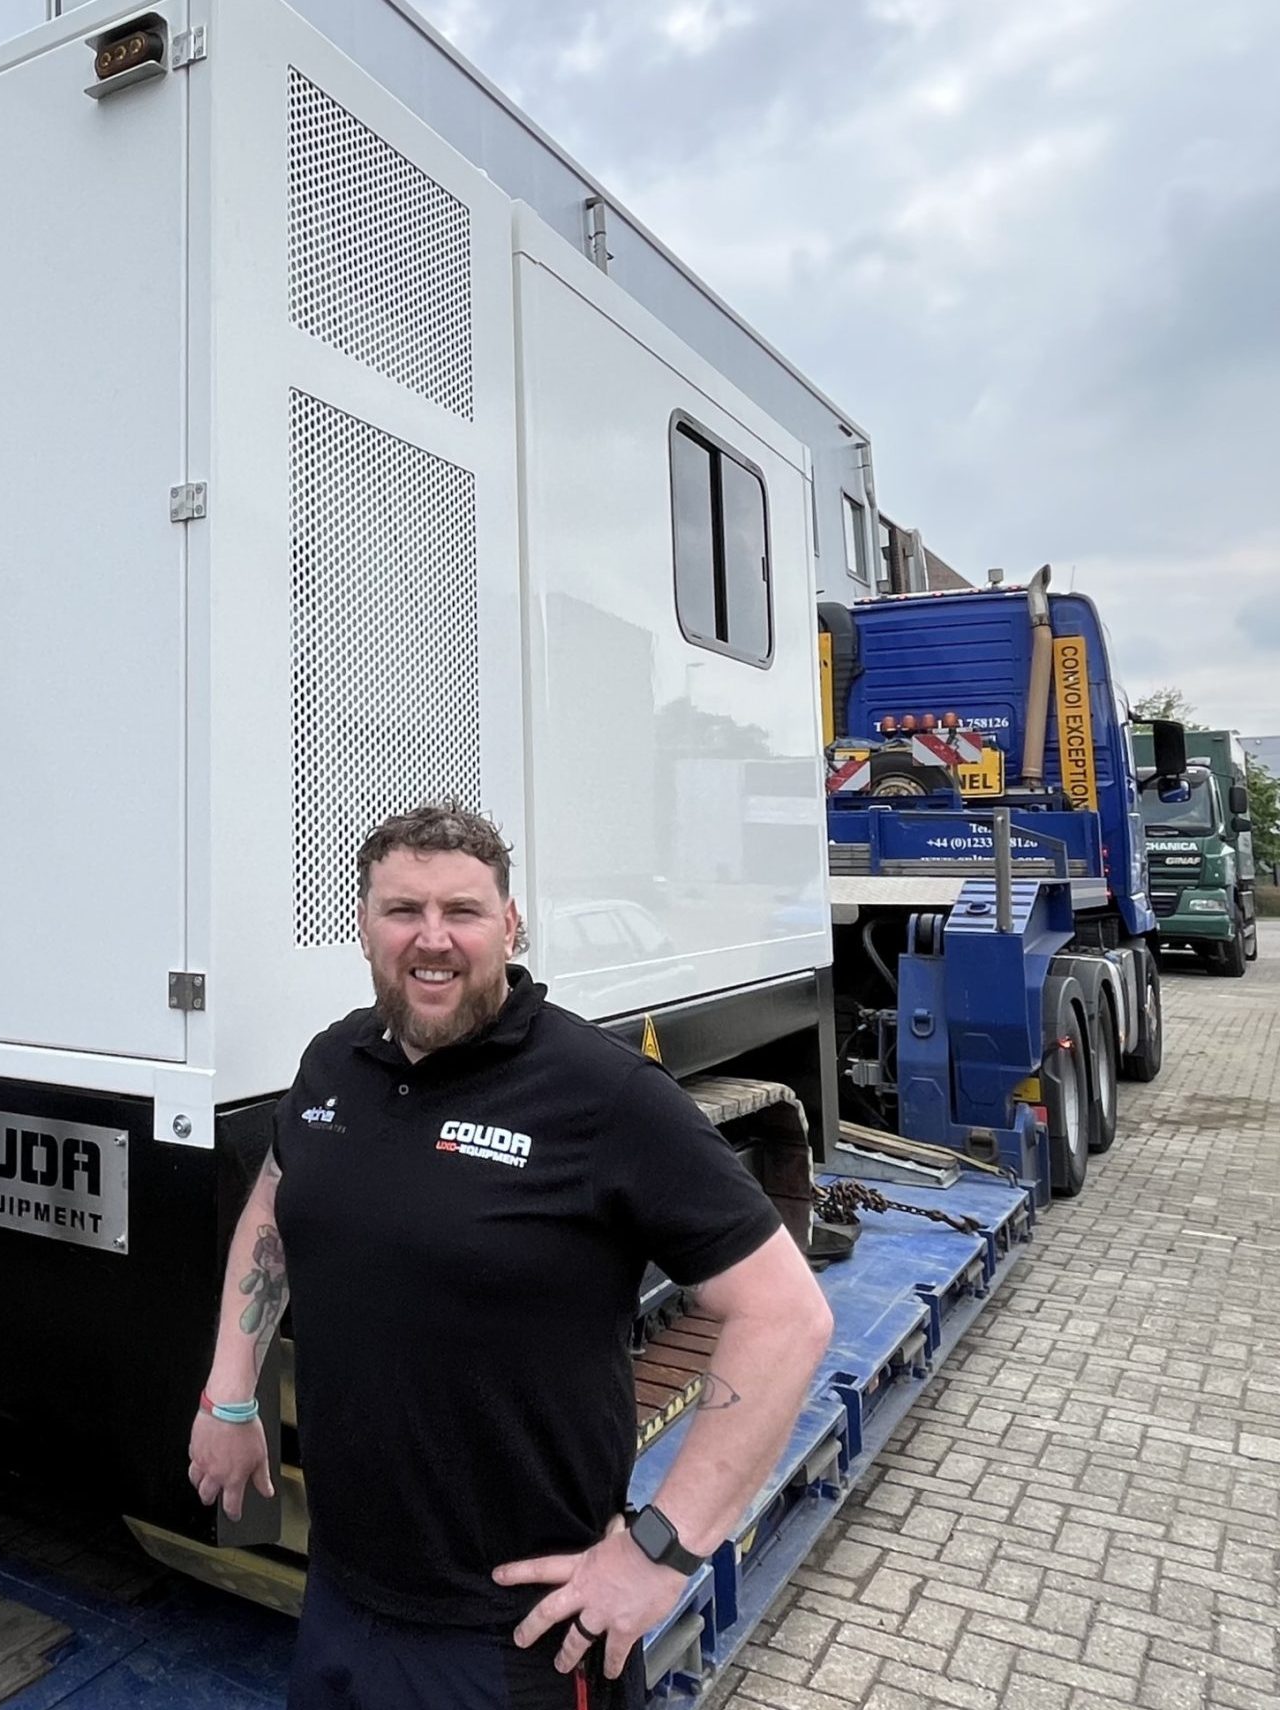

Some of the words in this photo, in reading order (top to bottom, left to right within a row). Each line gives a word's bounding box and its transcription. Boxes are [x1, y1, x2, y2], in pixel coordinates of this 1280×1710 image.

[1060, 645, 1082, 709] CONVOI
[968, 717, 1009, 728] 758126
[439, 1120, 532, 1157] GOUDA
